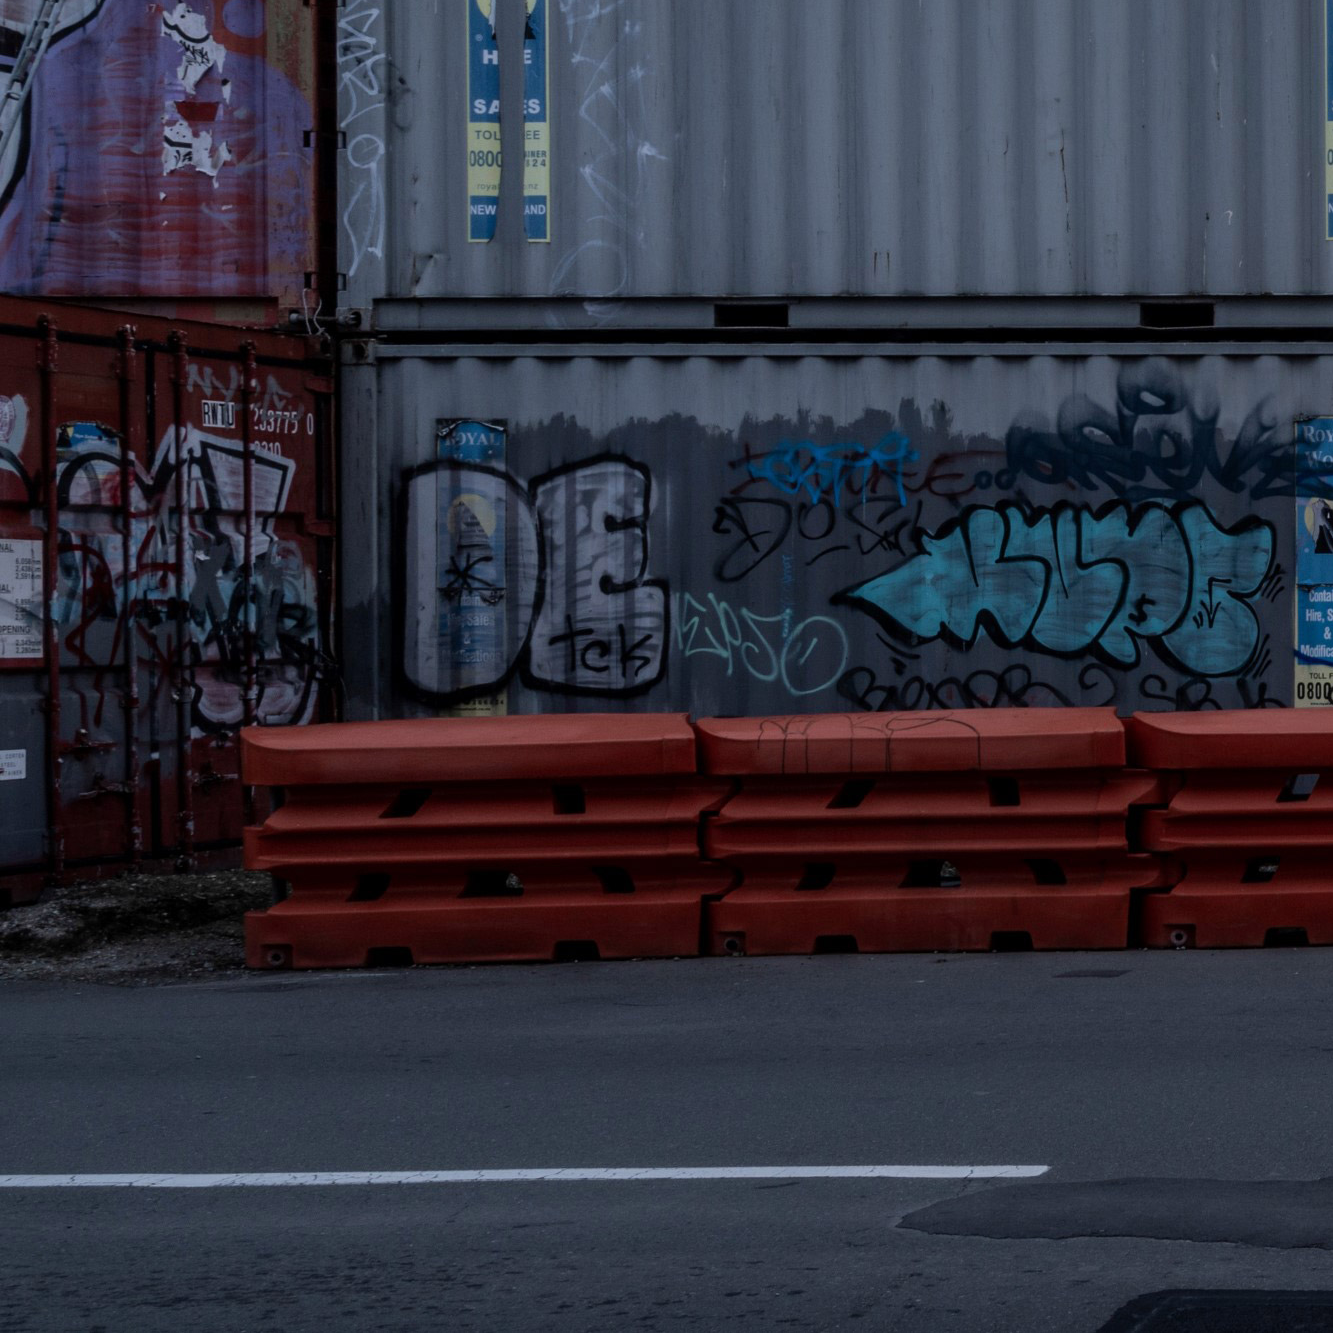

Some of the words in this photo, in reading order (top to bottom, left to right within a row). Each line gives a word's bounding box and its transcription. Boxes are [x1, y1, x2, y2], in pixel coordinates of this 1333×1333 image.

[470, 204, 497, 215] NEW
[1305, 608, 1325, 623] Hire,
[1323, 626, 1332, 640] &
[1297, 682, 1331, 699] 0800
